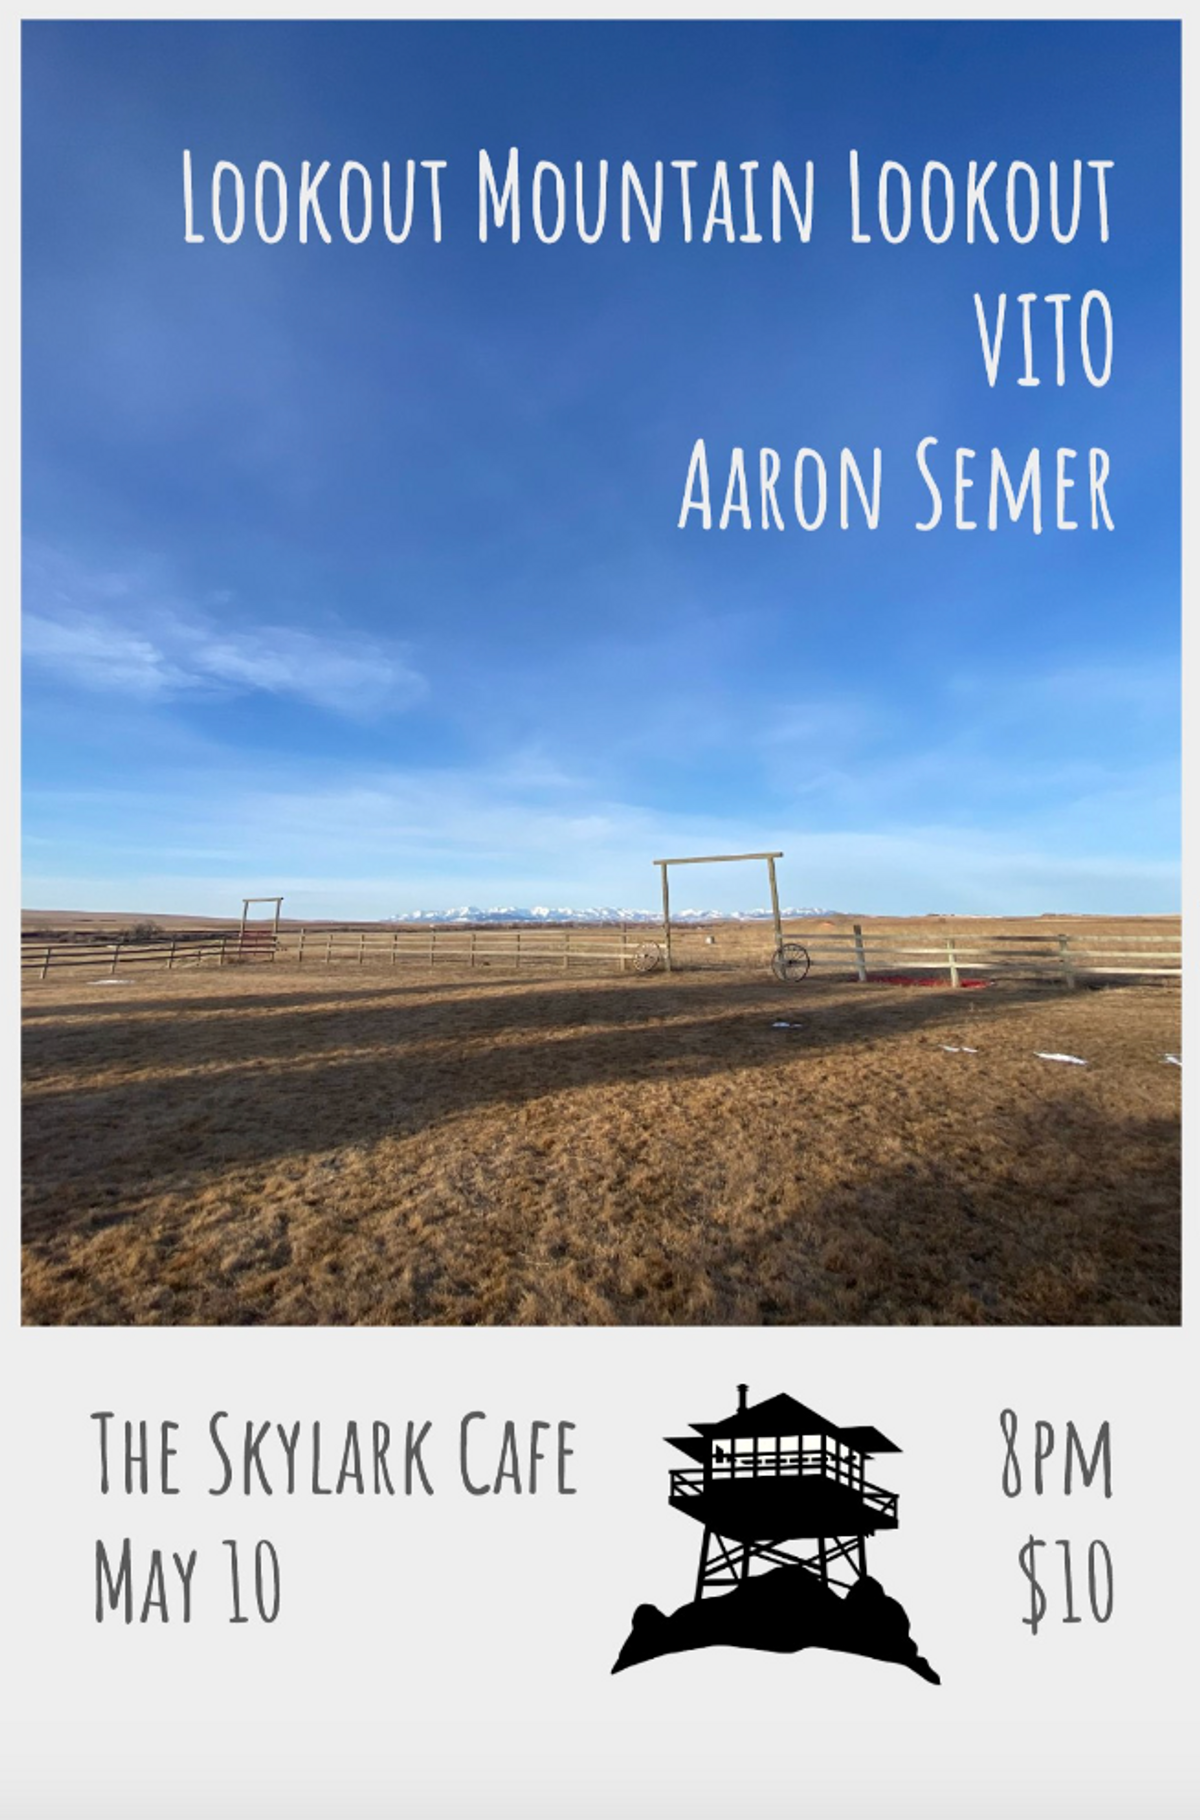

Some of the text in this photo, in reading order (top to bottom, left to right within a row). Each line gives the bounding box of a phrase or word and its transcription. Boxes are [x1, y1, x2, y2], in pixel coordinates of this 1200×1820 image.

[974, 289, 1113, 388] VITO
[221, 1539, 281, 1624] 10
[1018, 1534, 1114, 1636] $10
